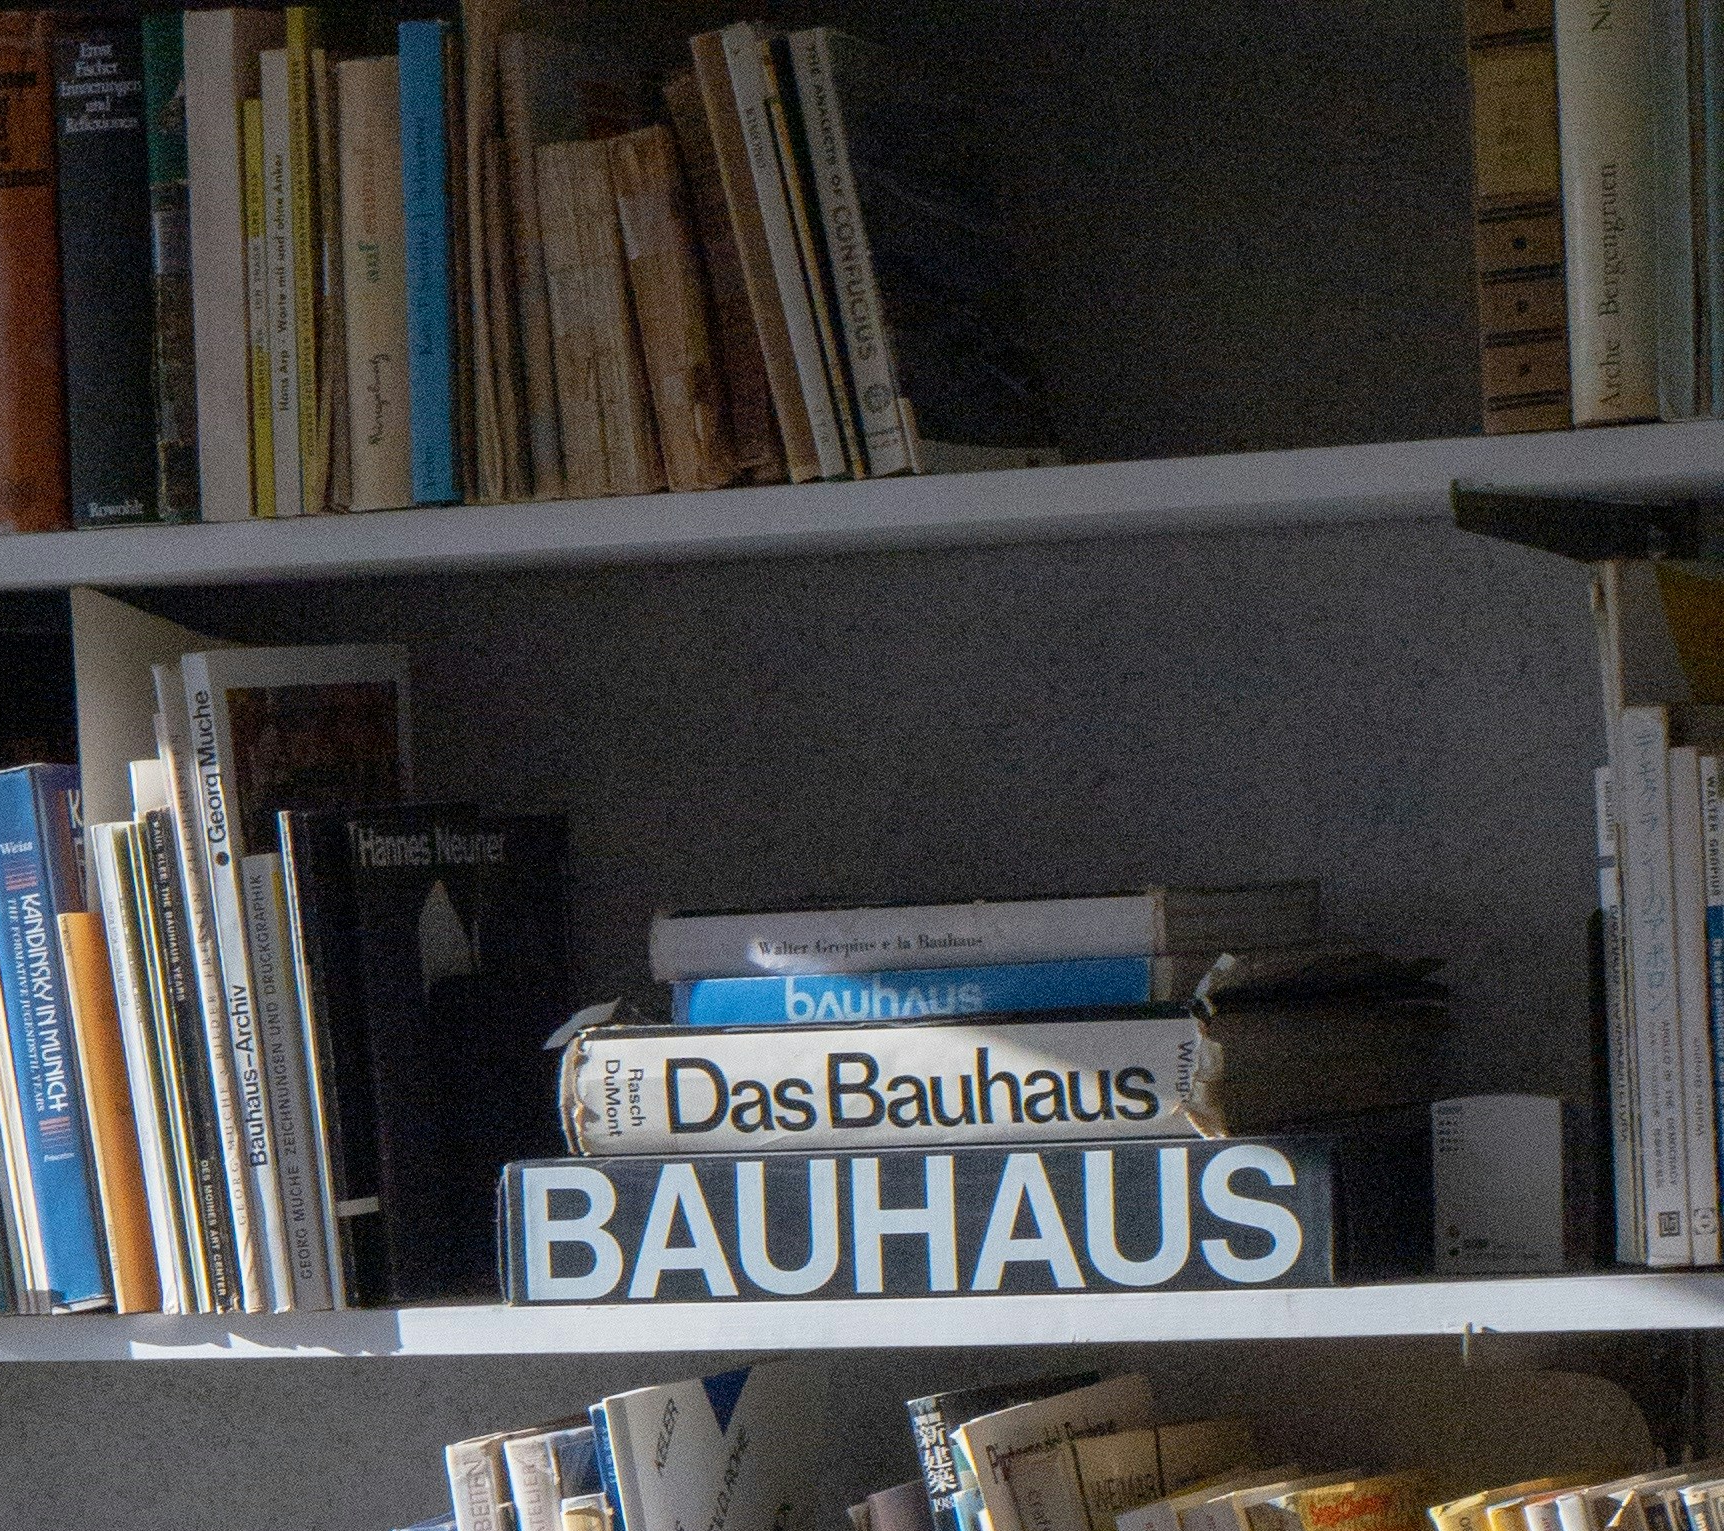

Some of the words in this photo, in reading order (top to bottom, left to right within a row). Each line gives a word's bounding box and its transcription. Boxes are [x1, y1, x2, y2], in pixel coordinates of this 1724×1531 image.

[805, 45, 822, 76] THE
[812, 83, 841, 166] ANALECTS
[1598, 162, 1624, 317] Bergengruen
[832, 203, 876, 362] CONFUCIUS
[1600, 338, 1622, 409] Arche
[189, 690, 217, 767] Muche
[199, 774, 228, 845] Georg
[1705, 774, 1718, 832] WALTER
[357, 827, 431, 868] Hannes
[1708, 836, 1722, 897] GROPIUS
[20, 891, 55, 1001] KANDINSKY
[248, 874, 277, 996] DRUCKGRAPHIK
[34, 1004, 58, 1026] IN
[265, 999, 283, 1038] UND
[39, 1029, 70, 1113] MUNICH
[271, 1041, 300, 1156] ZEICHNUNGEN
[604, 1058, 624, 1136] DuMont
[628, 1068, 647, 1128] Rasch
[663, 1056, 818, 1134] Das
[826, 1046, 1159, 1131] Bauhaus
[286, 1166, 308, 1222] MUCHE
[523, 1144, 1303, 1302] BAUHAUS
[295, 1226, 315, 1280] GEORG
[913, 1421, 959, 1495] 新建築
